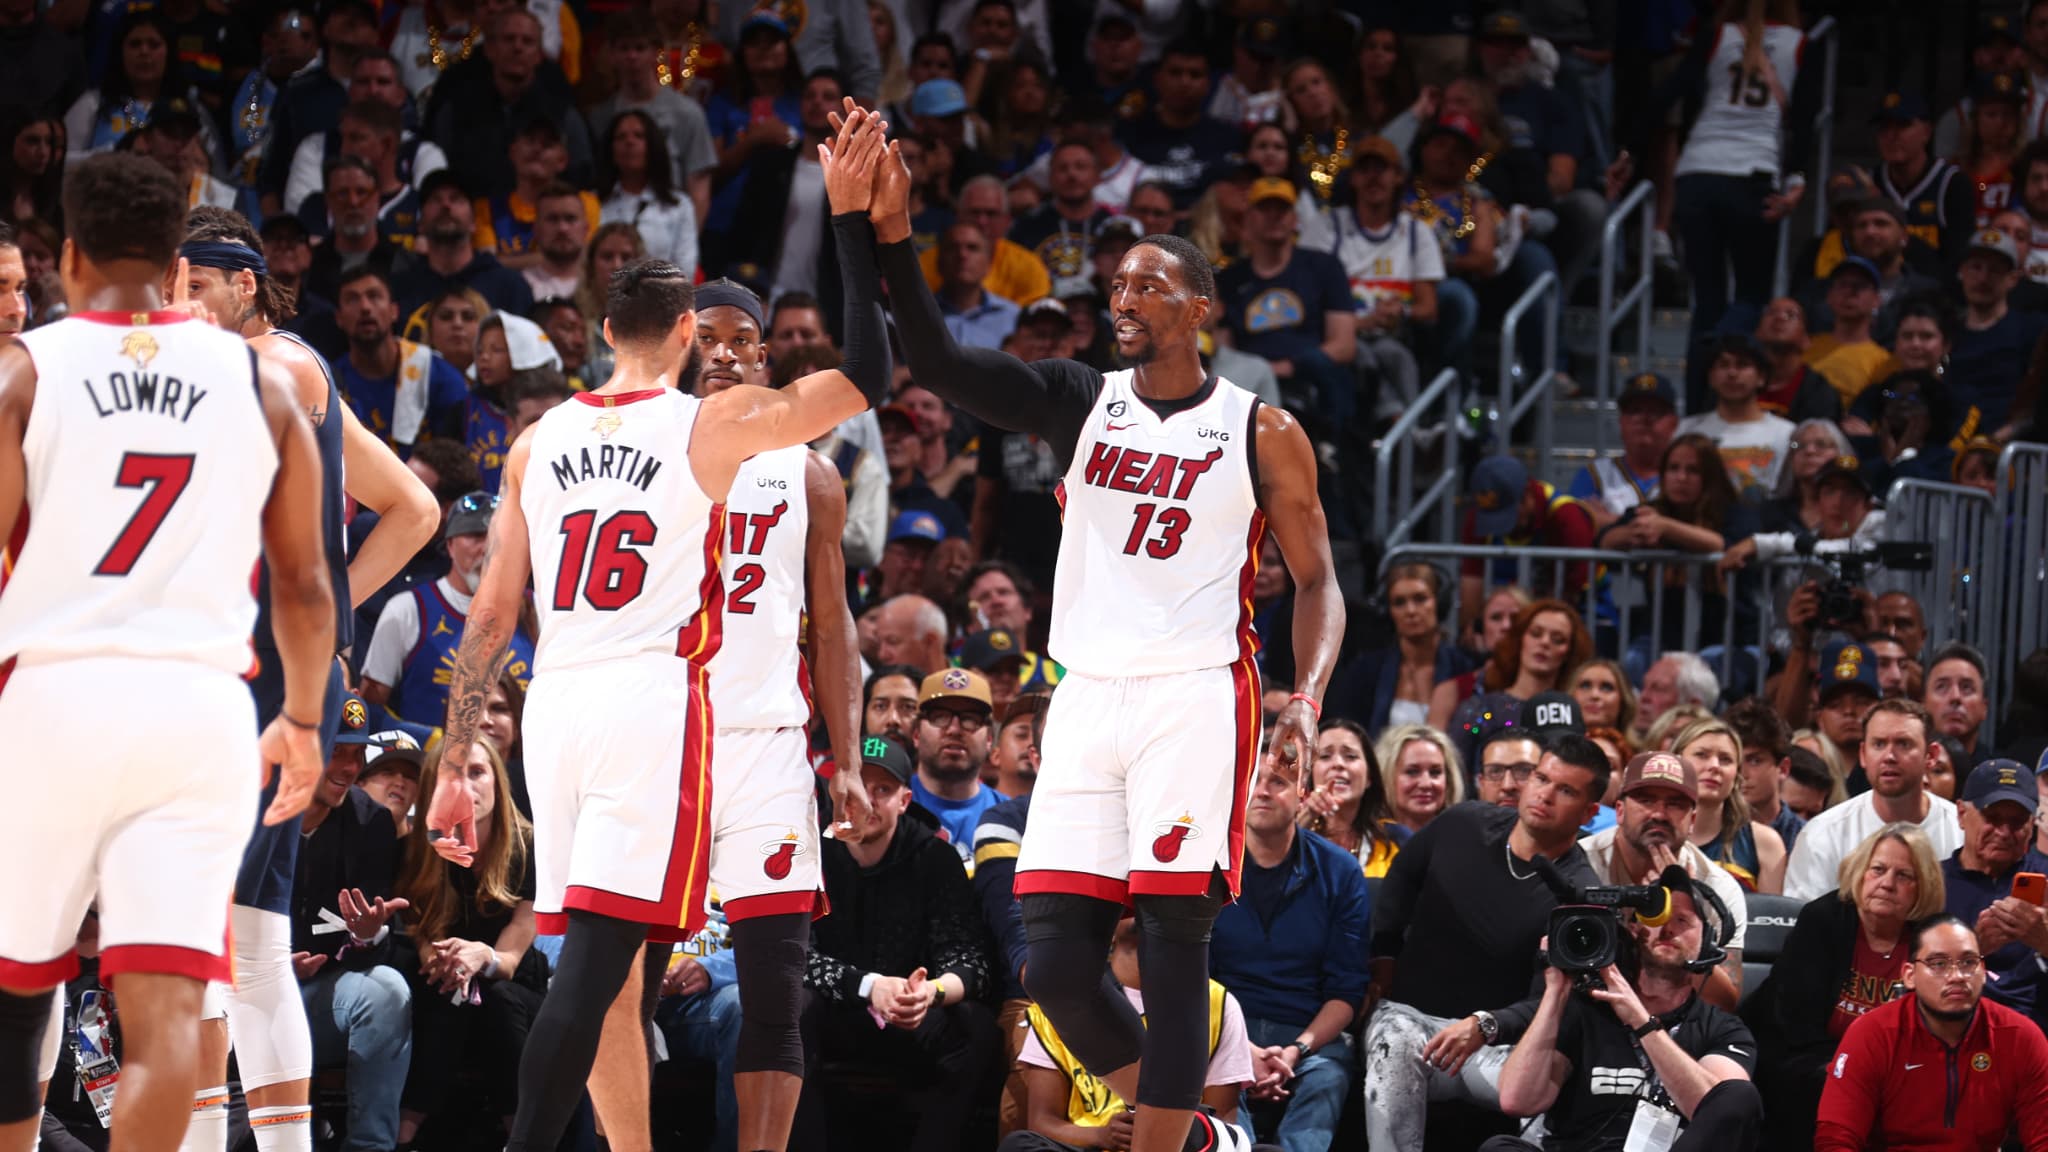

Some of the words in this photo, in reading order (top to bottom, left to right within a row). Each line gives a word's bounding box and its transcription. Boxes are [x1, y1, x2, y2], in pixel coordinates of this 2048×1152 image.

[84, 371, 208, 423] LOWRY
[551, 444, 662, 492] MARTIN
[1084, 442, 1223, 501] HEAT
[91, 452, 197, 577] 7
[1122, 502, 1193, 560] 13
[552, 508, 658, 611] 16
[727, 563, 767, 614] 2
[1536, 702, 1572, 726] DEN
